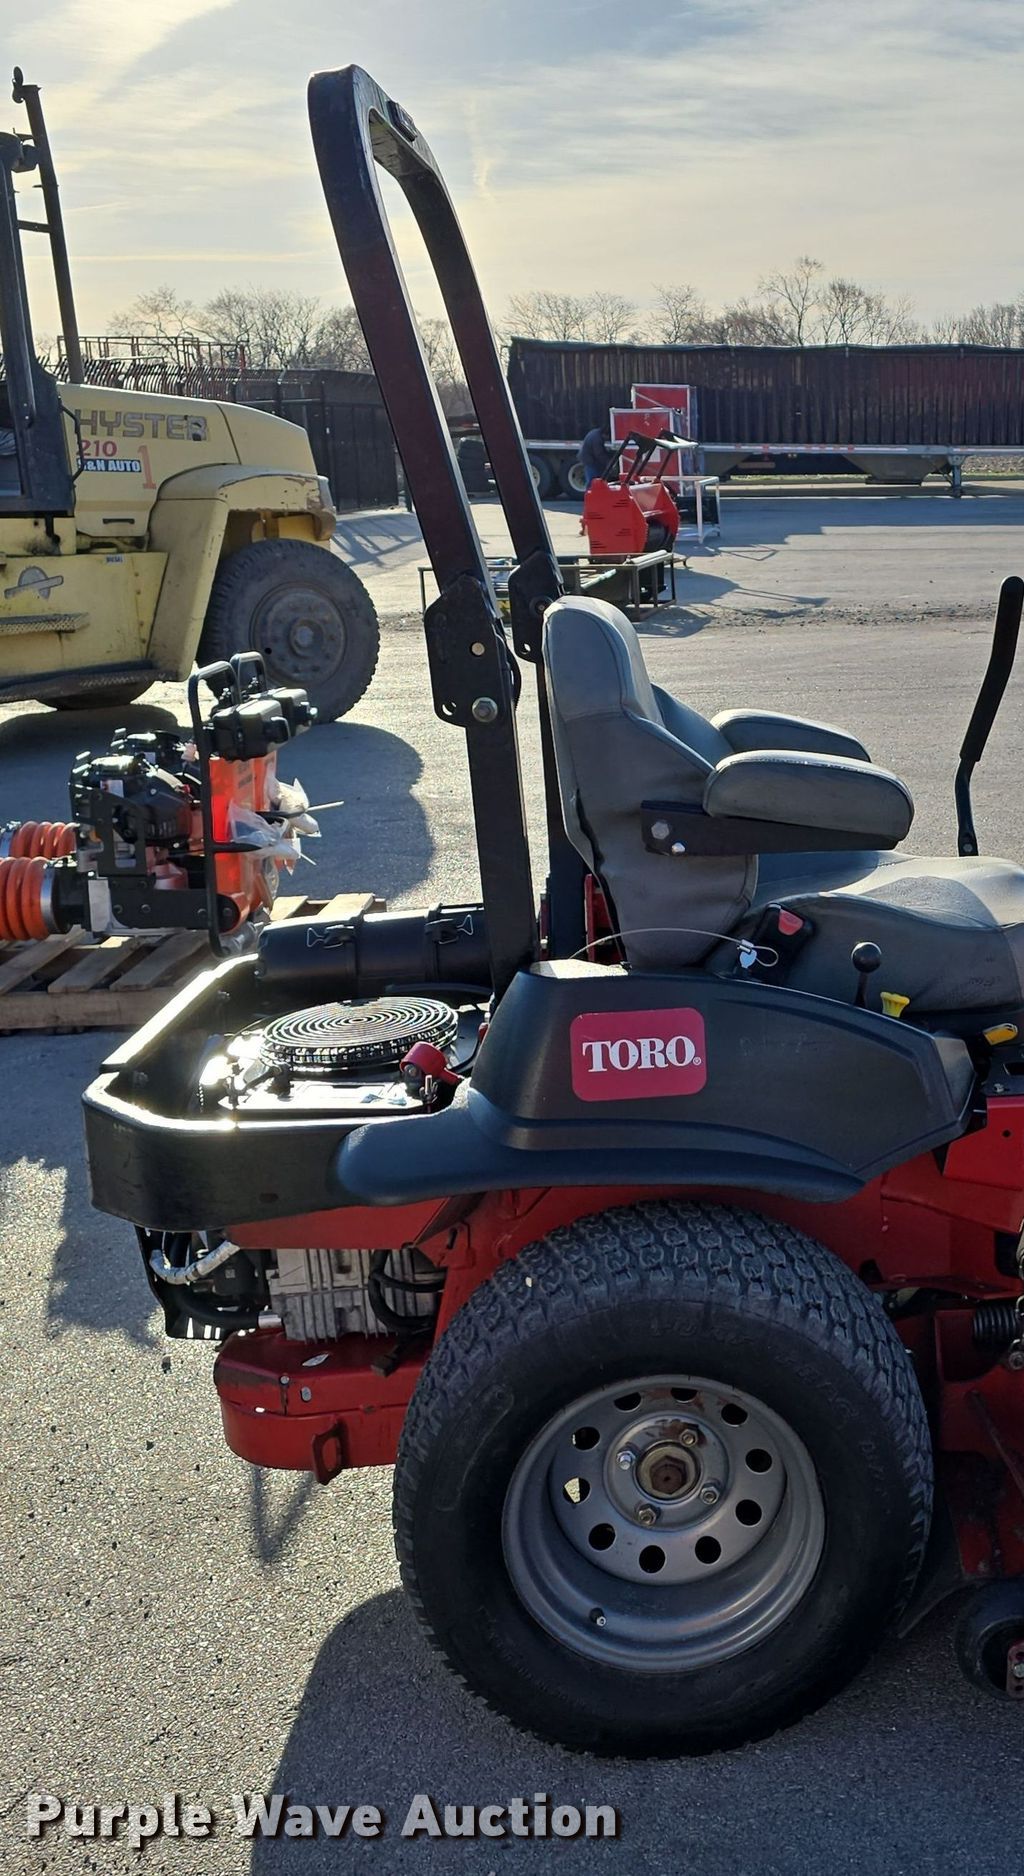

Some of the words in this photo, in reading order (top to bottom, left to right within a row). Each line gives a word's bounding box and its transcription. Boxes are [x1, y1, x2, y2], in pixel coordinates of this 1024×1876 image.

[74, 408, 208, 442] HYSTER
[77, 440, 118, 457] 210
[107, 459, 141, 472] AUTO
